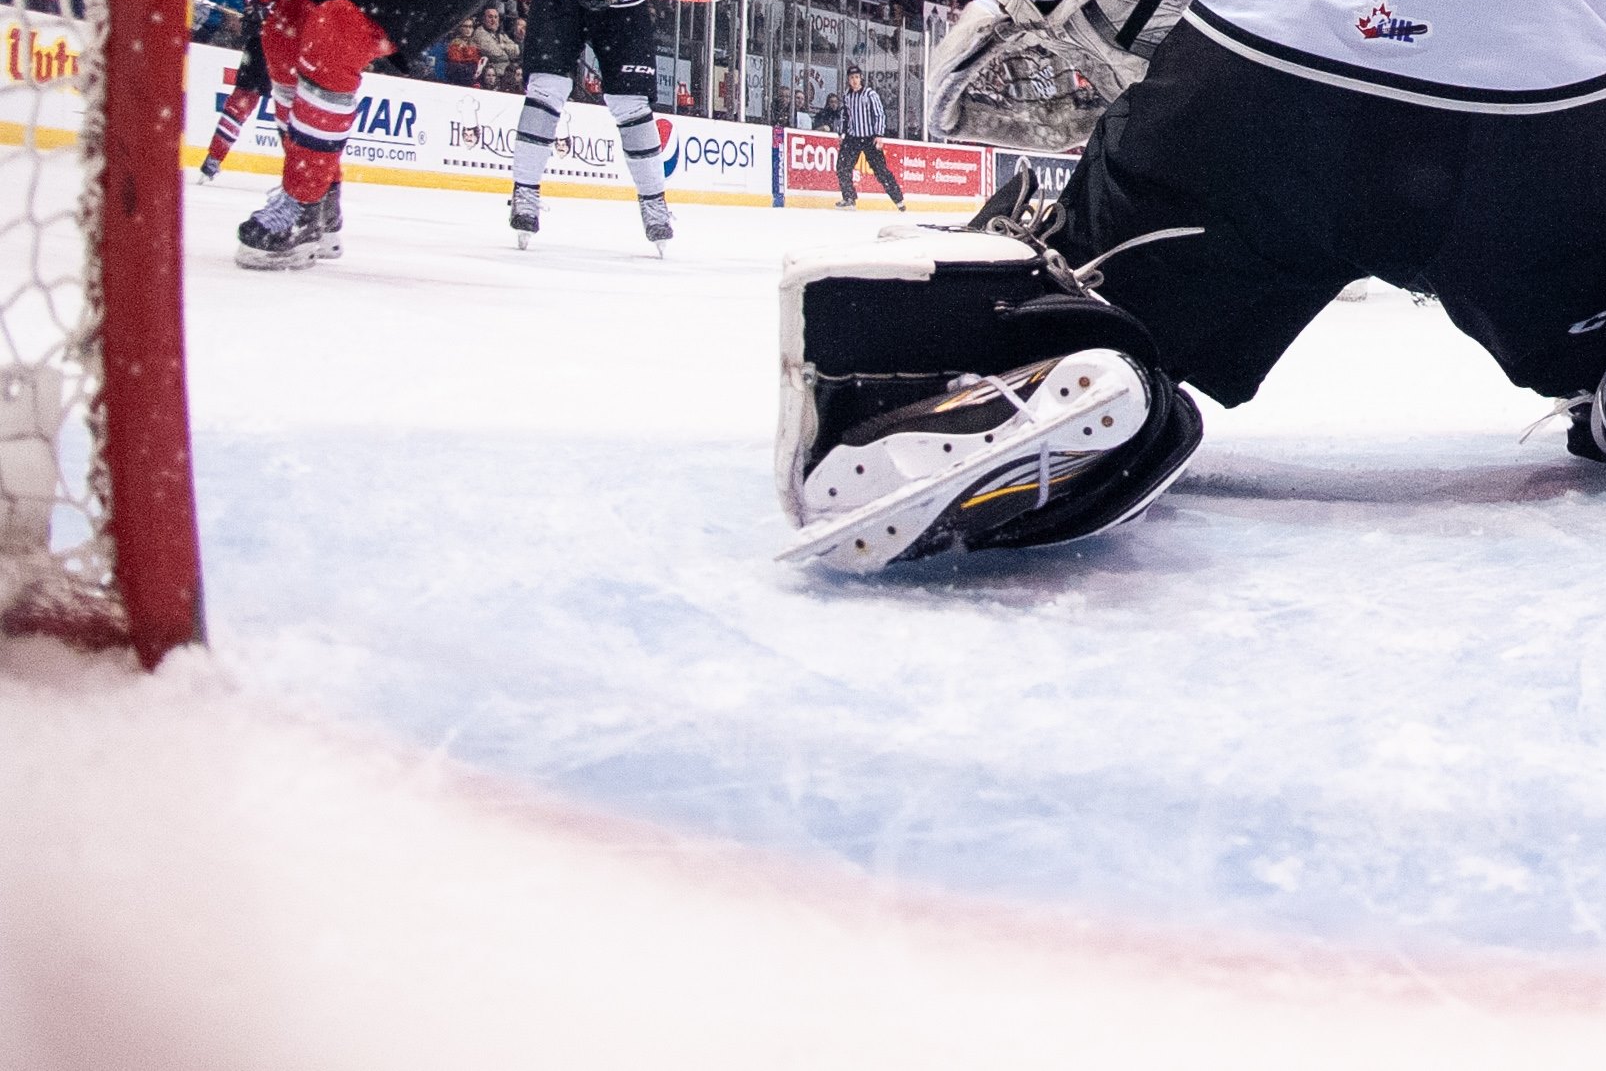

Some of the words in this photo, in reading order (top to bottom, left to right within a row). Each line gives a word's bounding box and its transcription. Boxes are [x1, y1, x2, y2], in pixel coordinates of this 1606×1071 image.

[621, 64, 656, 76] CCM
[685, 134, 755, 174] pepsi
[791, 136, 839, 172] Econ
